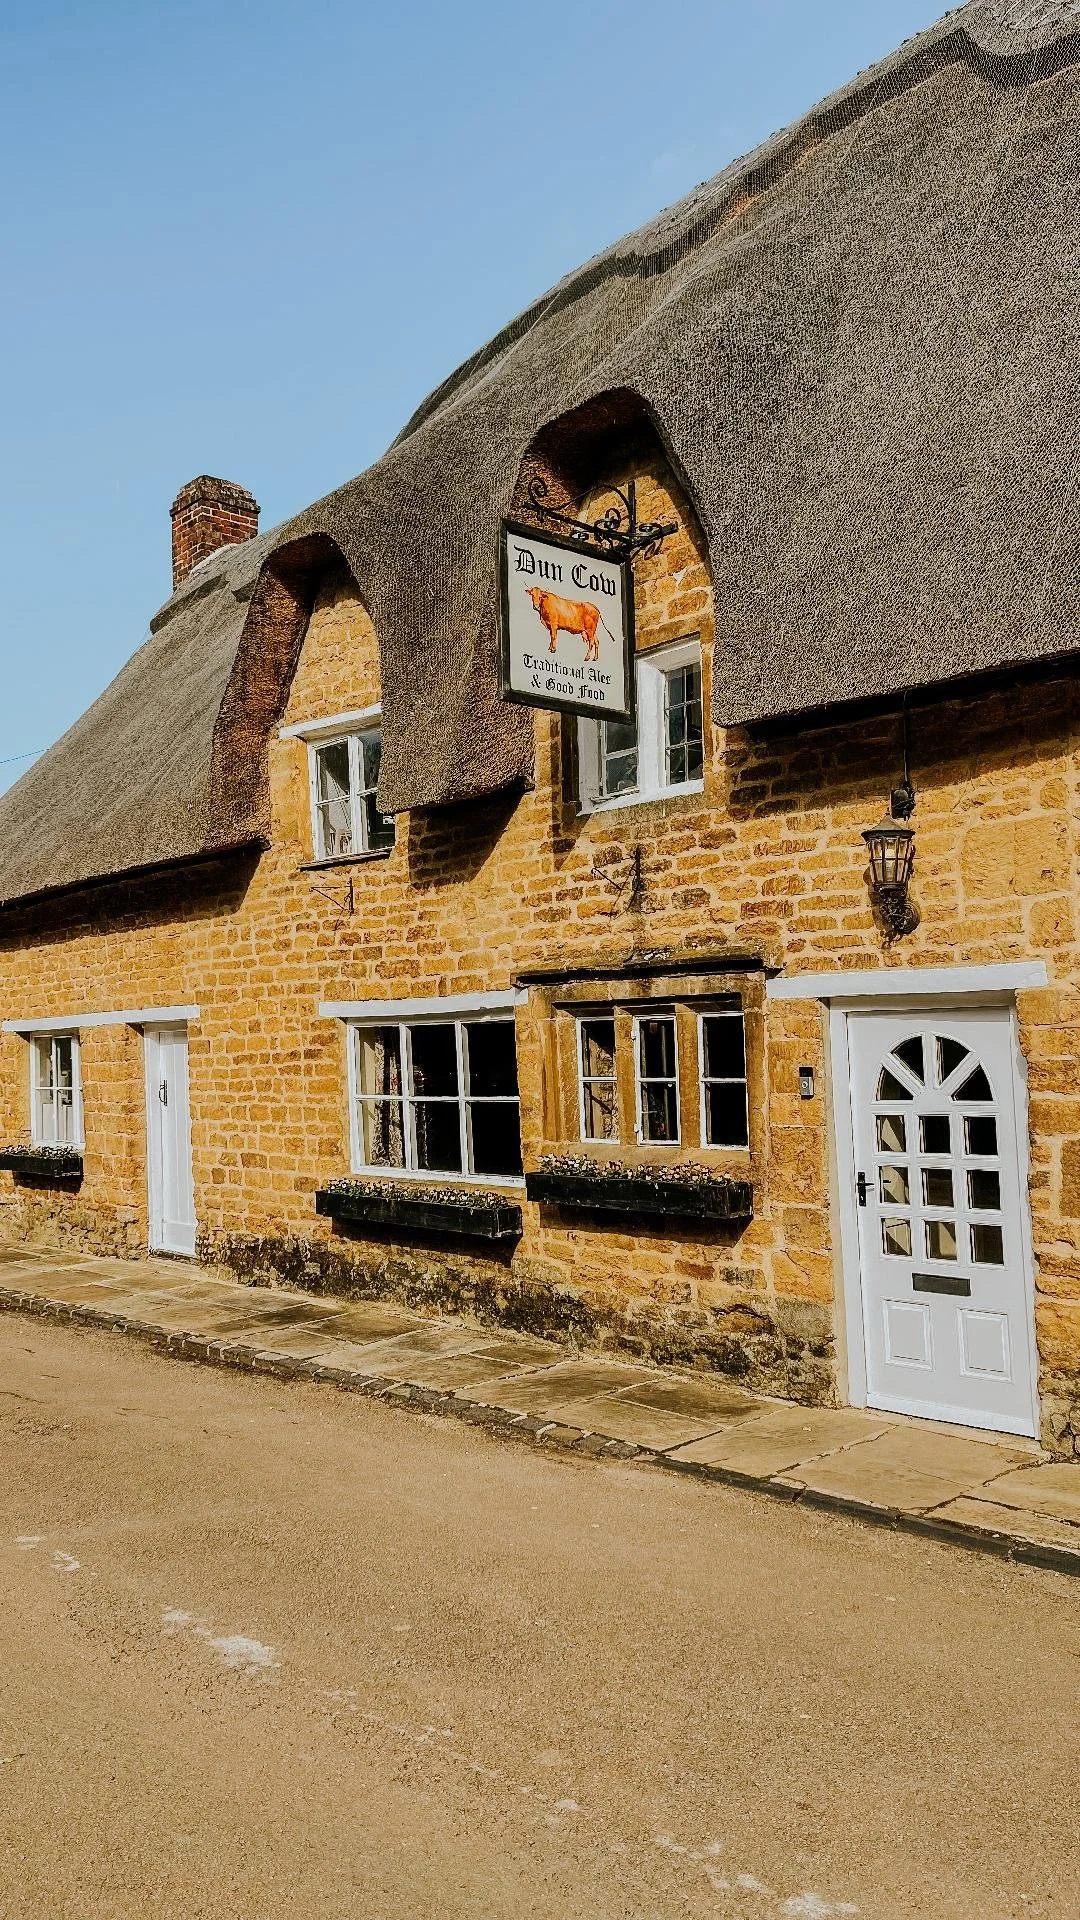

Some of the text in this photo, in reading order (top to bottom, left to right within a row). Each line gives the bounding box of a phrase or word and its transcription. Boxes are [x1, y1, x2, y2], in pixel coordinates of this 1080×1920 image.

[513, 544, 617, 596] Dun Cow
[522, 653, 612, 685] Traditional Ales
[530, 673, 605, 701] & Good Food
